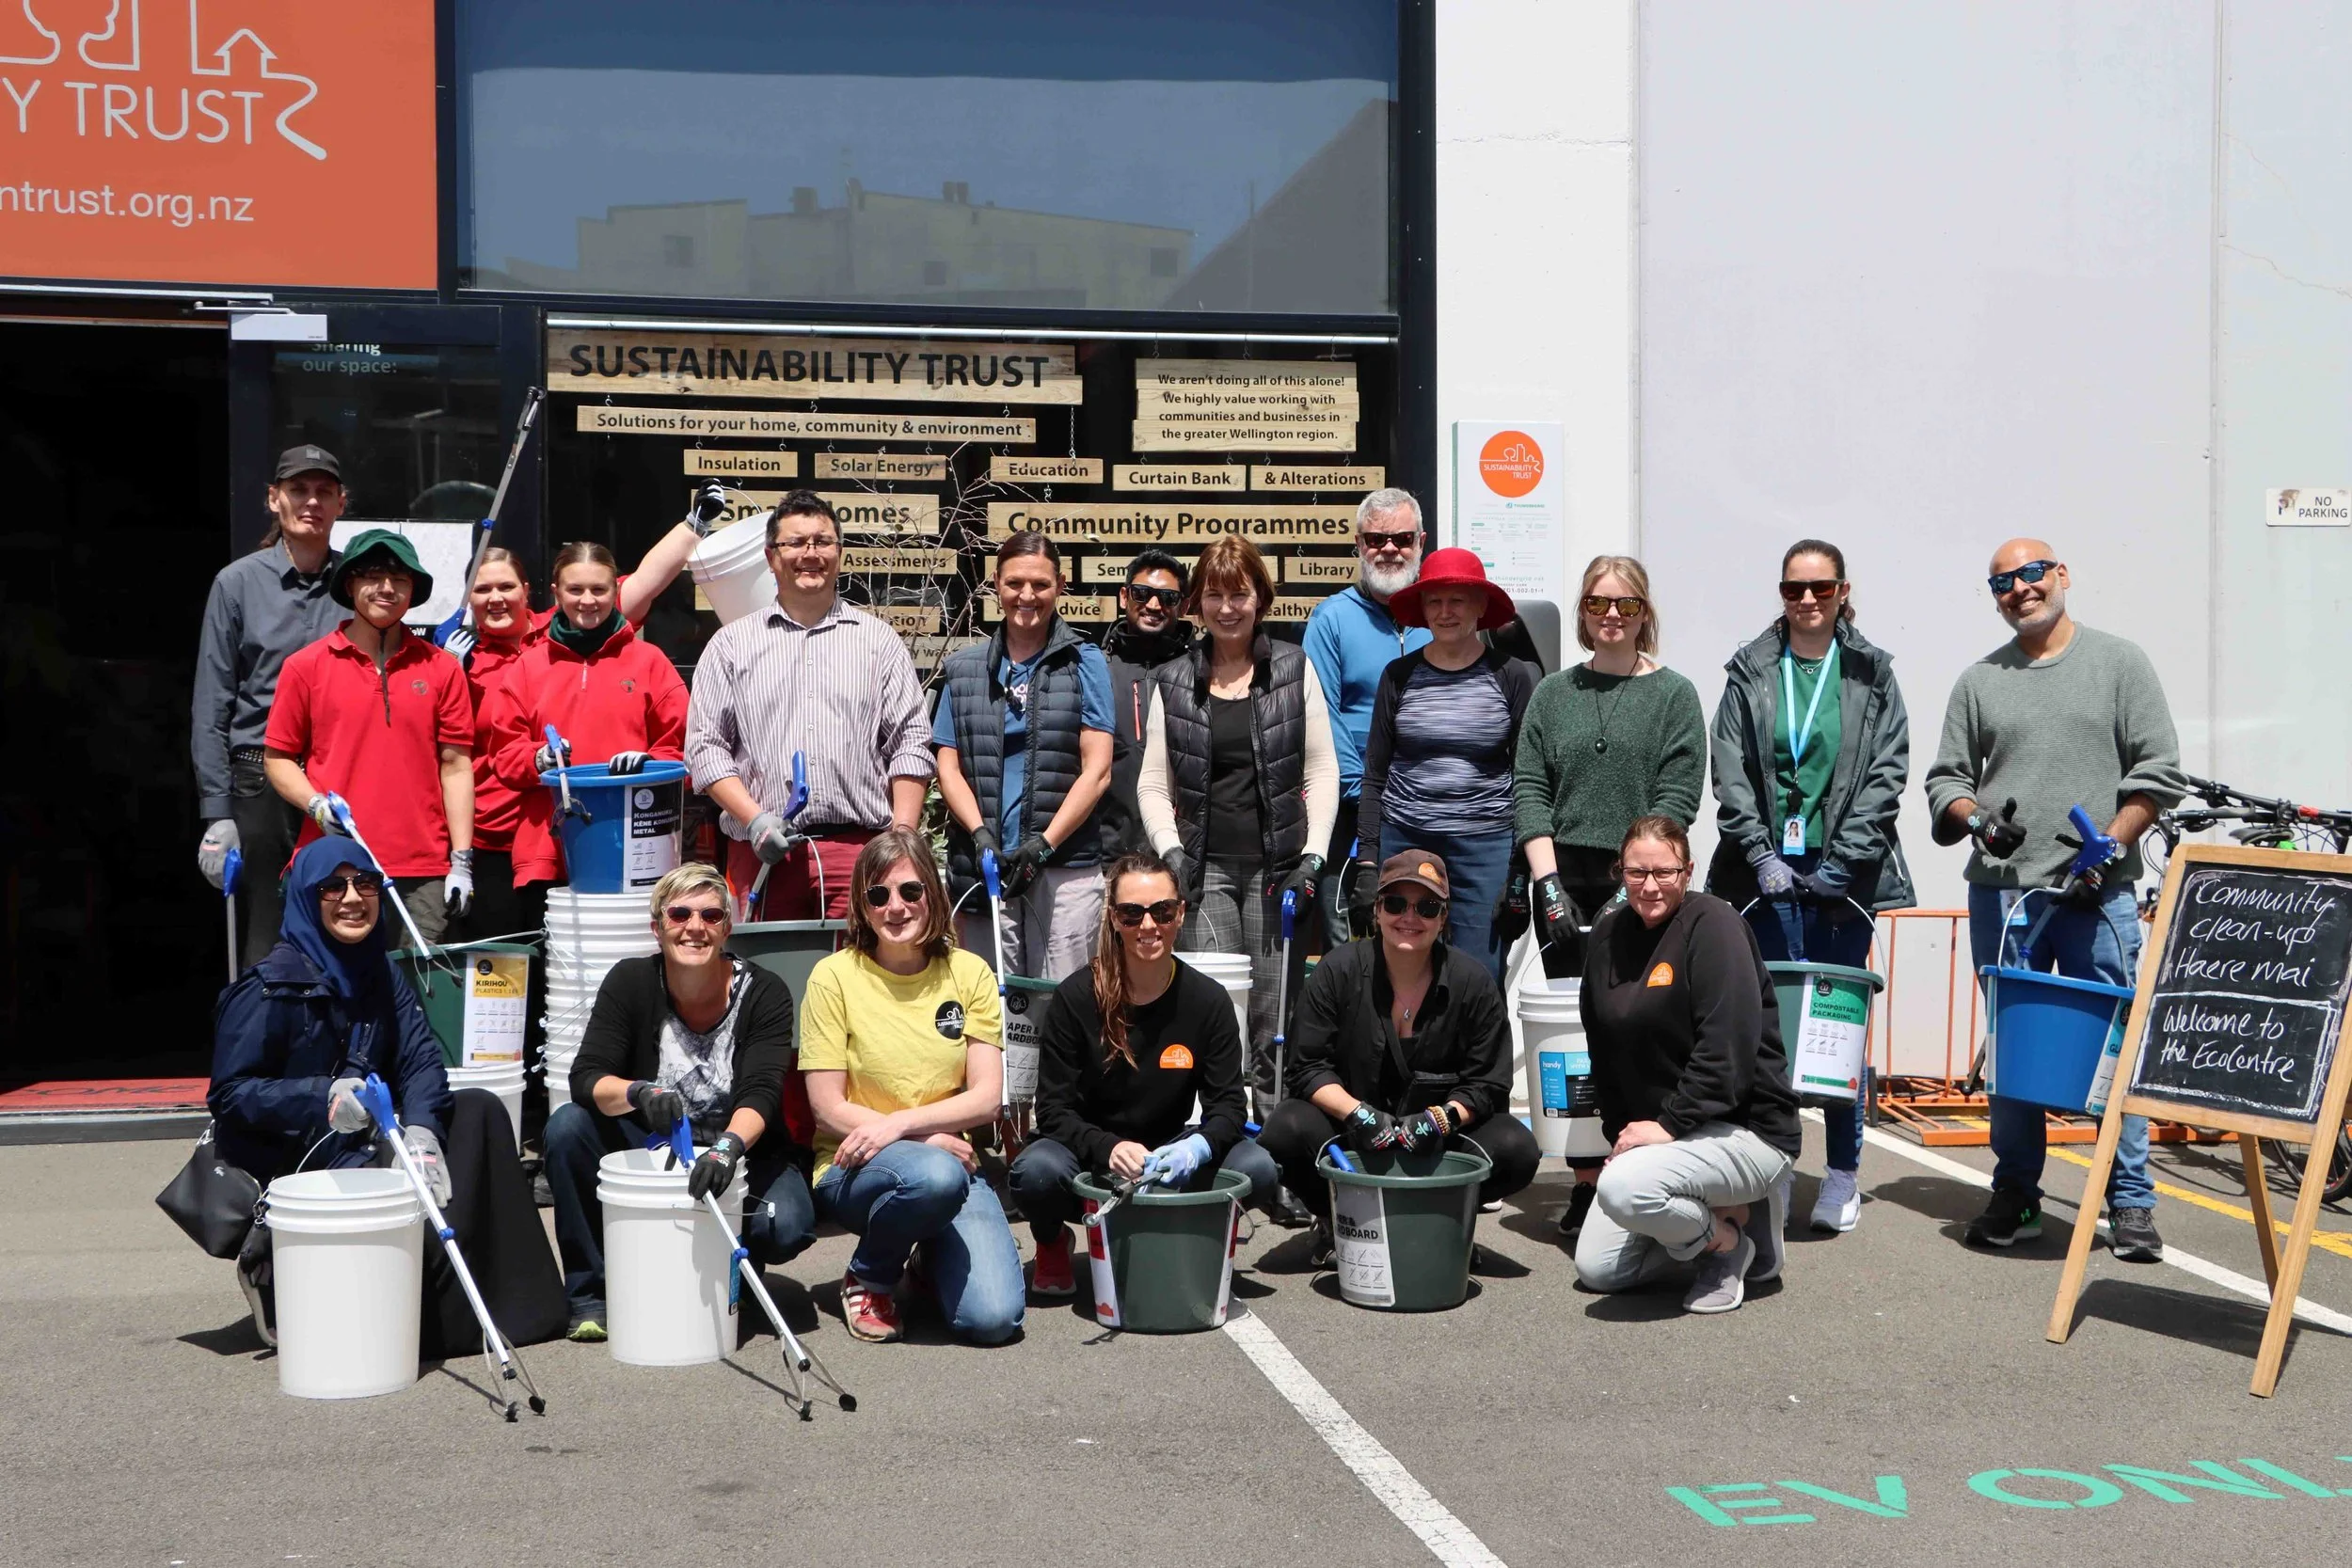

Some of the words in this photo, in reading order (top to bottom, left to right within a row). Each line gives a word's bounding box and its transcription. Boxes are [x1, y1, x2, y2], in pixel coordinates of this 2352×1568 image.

[64, 81, 264, 145] TRUST
[0, 181, 255, 228] ntrust.org.nz
[302, 359, 335, 372] our
[340, 360, 397, 375] space:
[569, 344, 910, 386] SUSTAINABILITY
[919, 352, 1050, 388] TRUST
[1157, 374, 1176, 385] We
[1216, 375, 1250, 388] doing
[1252, 375, 1267, 386] all
[1269, 375, 1282, 386] of
[1284, 375, 1306, 387] this
[1309, 375, 1345, 387] alone!
[1163, 393, 1182, 404] We
[1184, 393, 1221, 406] highly
[1224, 393, 1256, 404] value
[1259, 393, 1308, 406] working
[1310, 394, 1336, 404] with
[1159, 411, 1235, 422] communities
[1238, 411, 1261, 422] and
[1263, 411, 1327, 422] businesses
[1329, 412, 1341, 422] in
[596, 413, 675, 430] Solutions
[679, 414, 704, 430] for
[707, 418, 746, 435] your
[750, 416, 802, 434] home,
[804, 419, 898, 437] community
[902, 420, 914, 434] &
[917, 421, 1023, 436] environment
[1161, 429, 1182, 439] the
[1184, 430, 1227, 441] greater
[1229, 429, 1294, 441] Wellington
[1296, 430, 1338, 442] region.
[698, 456, 781, 471] Insulation
[831, 458, 875, 472] Solar
[877, 460, 934, 477] Energy
[1009, 463, 1089, 477] Education
[1129, 471, 1187, 484] Curtain
[1192, 472, 1231, 485] Bank
[1264, 471, 1277, 485] &
[1280, 472, 1366, 485] Alterations
[2314, 497, 2332, 506] NO
[829, 500, 910, 523] omes
[2298, 508, 2348, 518] PARKING
[1008, 513, 1169, 541] Community
[1177, 514, 1350, 536] Programmes
[843, 552, 946, 568] Assessments
[1299, 562, 1355, 579] Library
[1055, 602, 1101, 615] dvice
[1266, 603, 1311, 620] ealthy
[2195, 879, 2336, 927] Community
[2174, 947, 2247, 981] Haere
[1812, 1009, 1851, 1021] PACKAGING
[1813, 1002, 1859, 1014] COMPOSTABLE
[1007, 1022, 1032, 1035] APER
[2163, 1004, 2255, 1037] Welcome
[2260, 1007, 2284, 1040] to
[1008, 1033, 1041, 1045] ARDBO
[2160, 1037, 2189, 1066] the
[1966, 1455, 2352, 1509] ONL
[1664, 1475, 1909, 1528] EV
